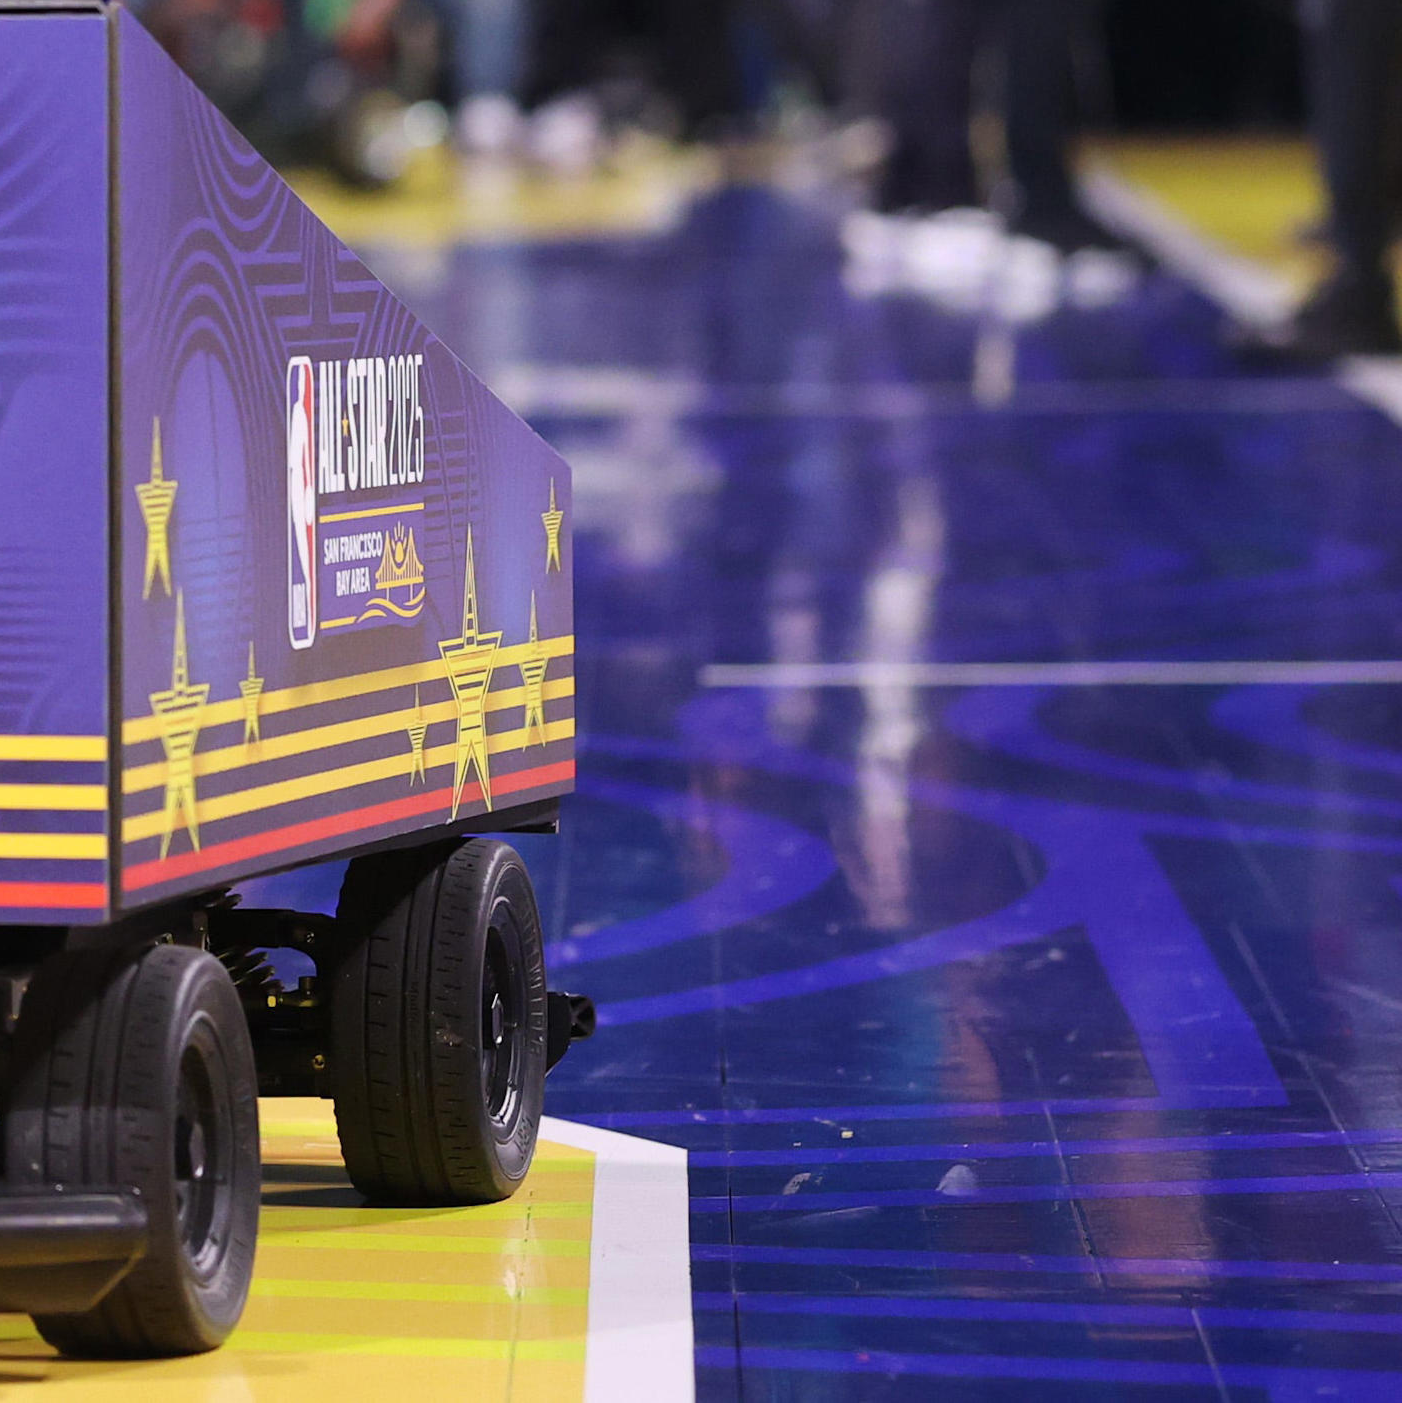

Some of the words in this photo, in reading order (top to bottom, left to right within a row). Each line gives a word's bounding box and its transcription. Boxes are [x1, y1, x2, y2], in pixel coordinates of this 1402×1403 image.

[319, 359, 345, 494] ALL
[347, 356, 387, 491] STAR
[388, 354, 424, 484] 2025
[324, 536, 342, 565] SAN
[341, 531, 383, 563] FRANCISCO
[336, 568, 353, 597] BAY
[351, 566, 371, 594] AREA
